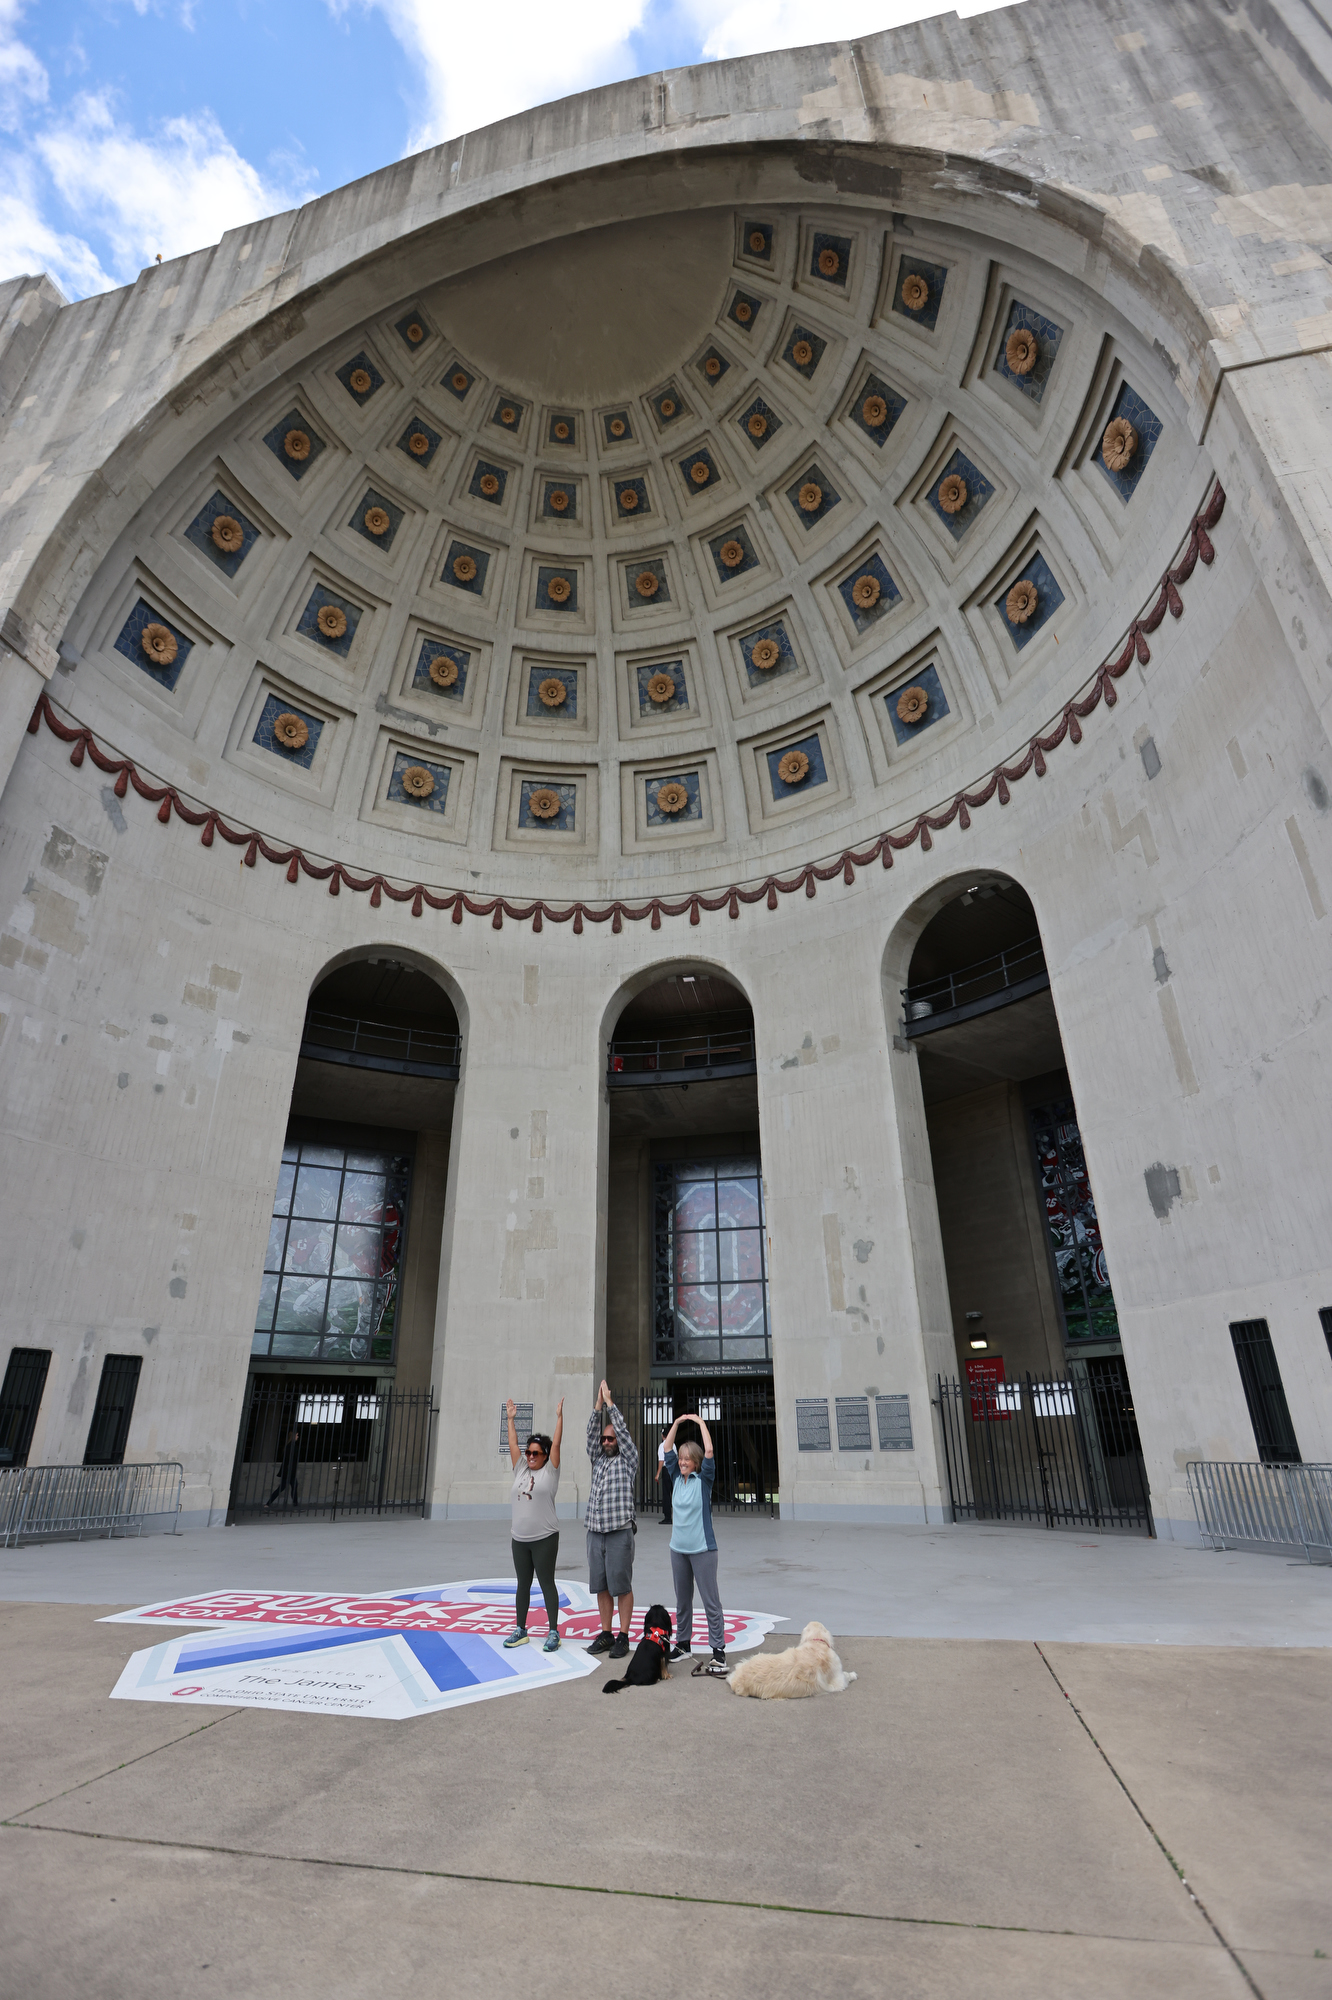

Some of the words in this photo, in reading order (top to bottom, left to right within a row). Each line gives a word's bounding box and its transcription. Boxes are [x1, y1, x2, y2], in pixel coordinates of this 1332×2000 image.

[154, 1607, 237, 1618] FOR
[233, 1611, 268, 1619] A
[261, 1667, 356, 1677] PRESENTED
[239, 1675, 281, 1685] The
[284, 1678, 366, 1691] James
[282, 1698, 323, 1706] CANCER
[324, 1701, 364, 1709] CENTER
[303, 1693, 375, 1704] UNIVERSITY
